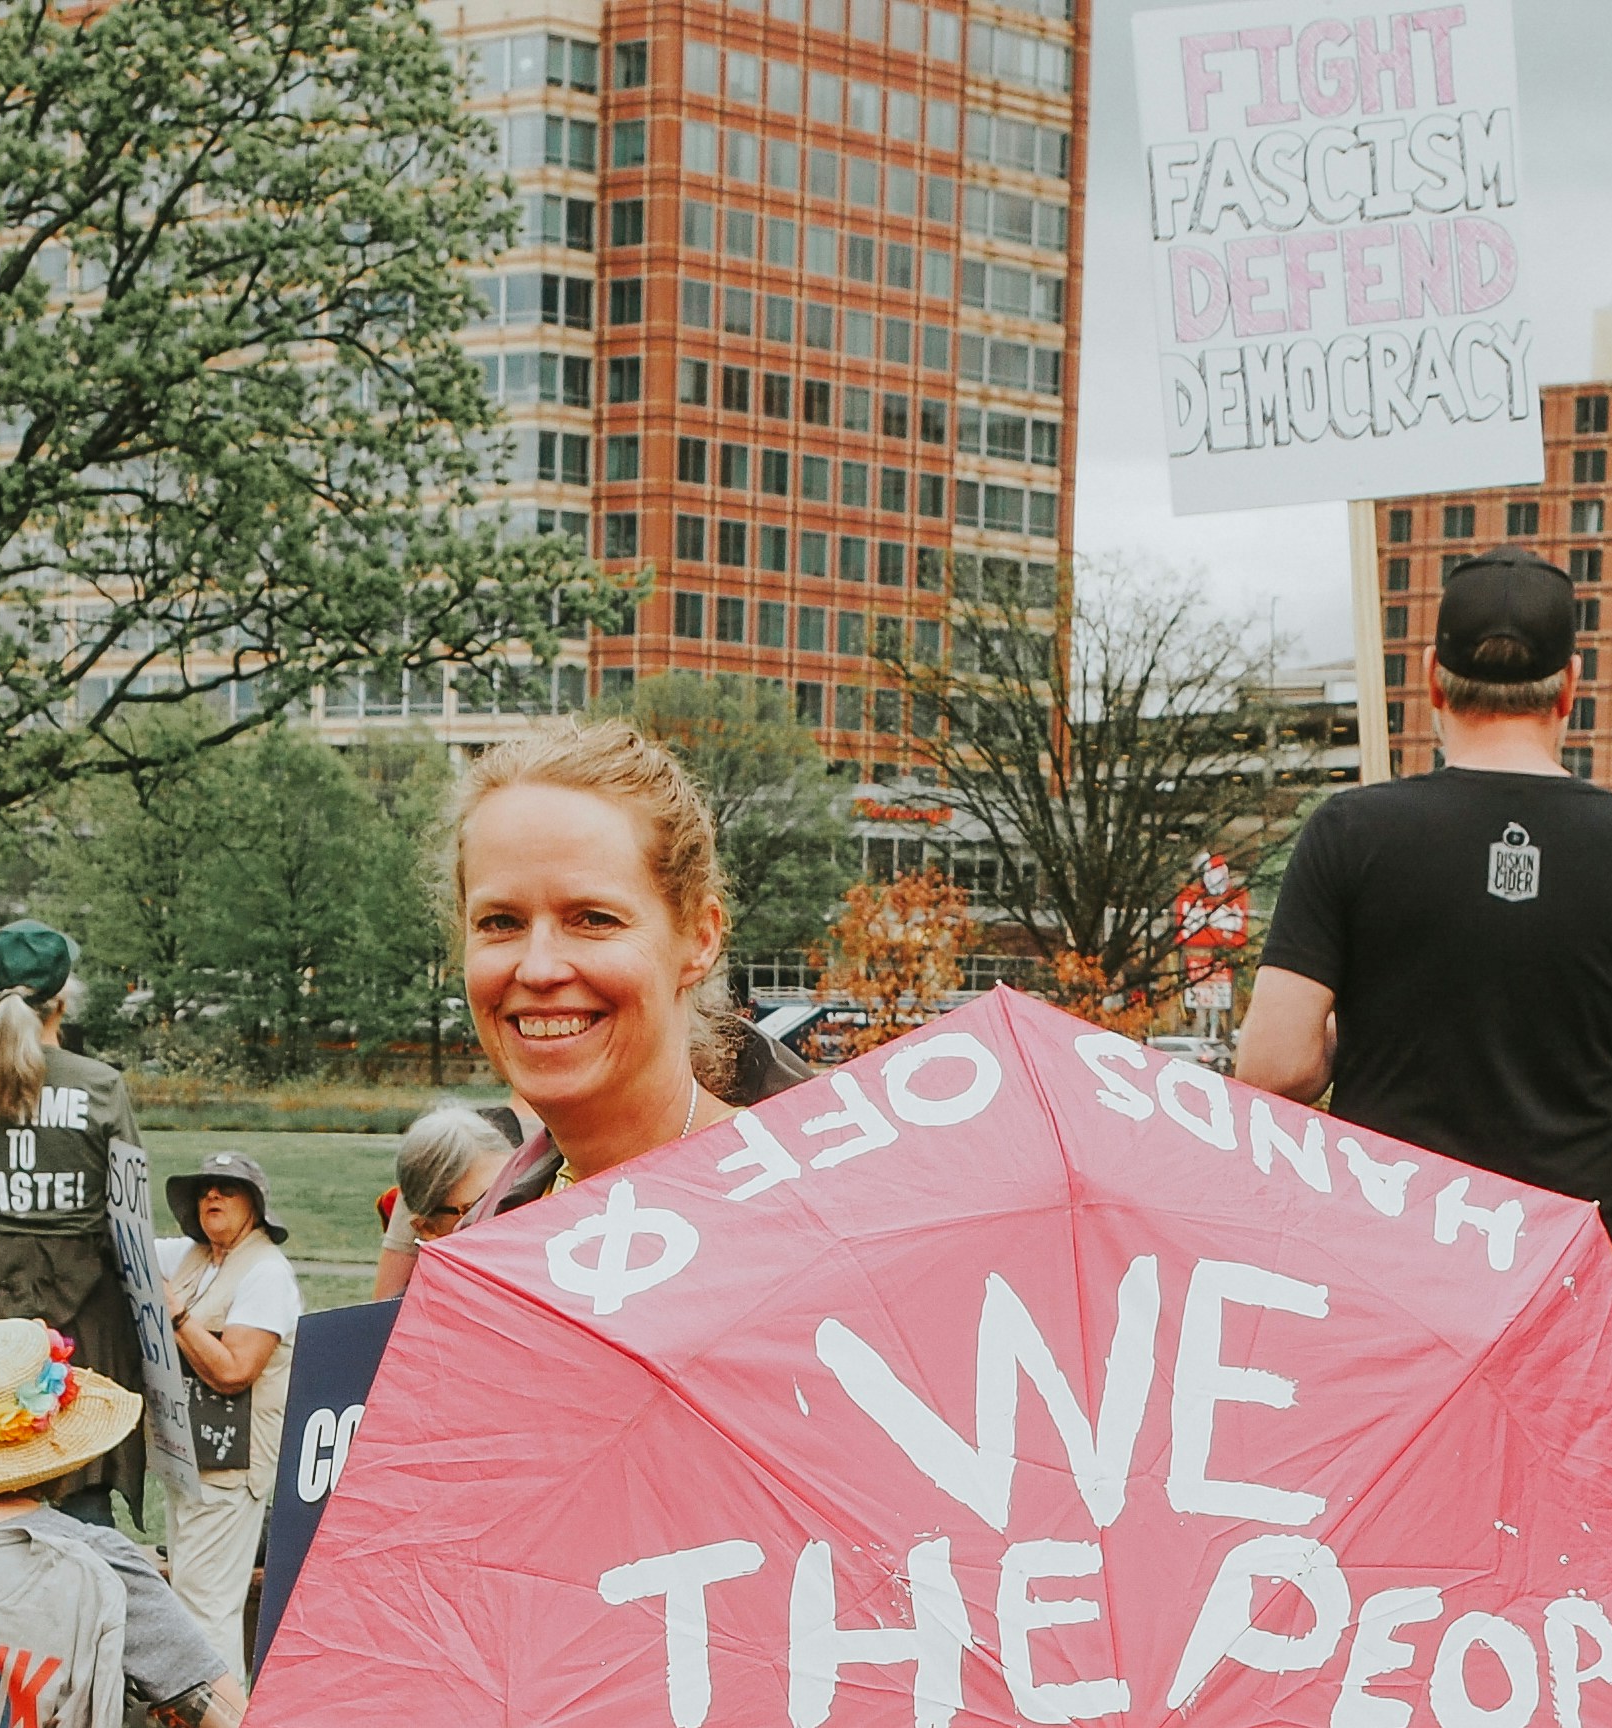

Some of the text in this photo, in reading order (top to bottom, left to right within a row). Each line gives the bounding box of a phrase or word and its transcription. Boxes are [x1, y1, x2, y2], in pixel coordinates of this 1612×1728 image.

[1181, 5, 1466, 132] FIGHT
[1148, 107, 1517, 241] FASCISM
[1169, 216, 1518, 343] DEFEND
[1161, 320, 1533, 457] DEMOCRACY
[1495, 868, 1533, 892] CIDER
[1497, 851, 1534, 871] DISKIN
[6, 1129, 36, 1171] TO
[716, 1030, 1527, 1272] HANDS OFF
[815, 1255, 1329, 1529] WE
